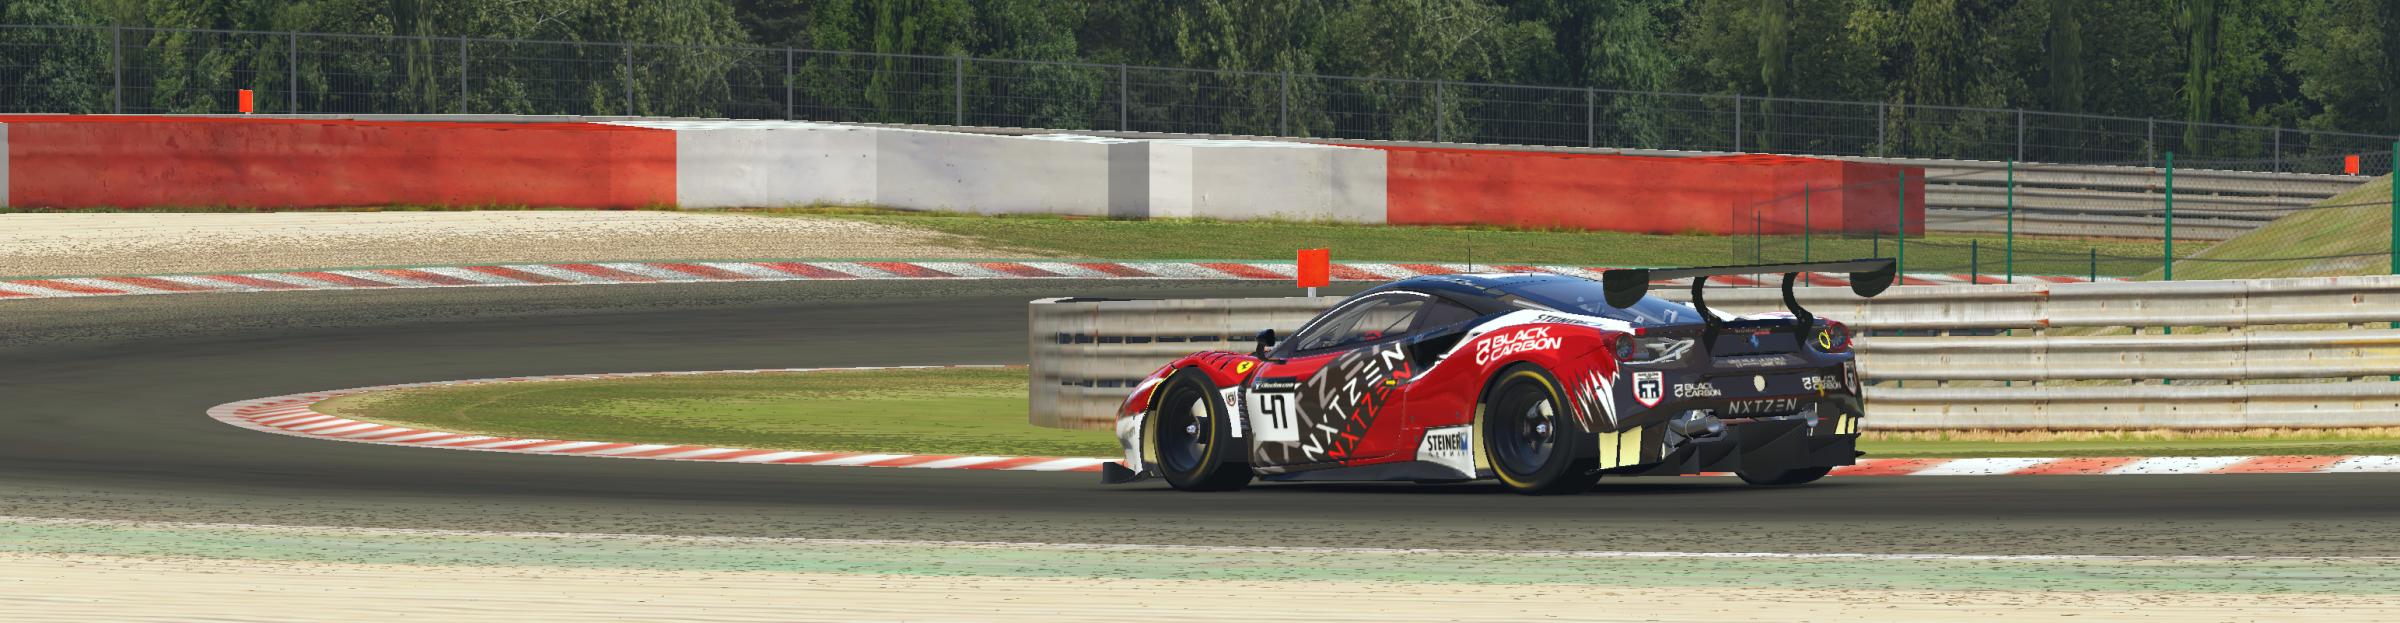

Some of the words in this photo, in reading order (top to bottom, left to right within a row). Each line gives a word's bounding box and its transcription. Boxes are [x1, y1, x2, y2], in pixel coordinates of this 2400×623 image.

[1492, 326, 1551, 349] BLACK
[1490, 337, 1562, 361] CARBON
[1684, 382, 1713, 390] BLACK
[1684, 389, 1722, 397] CARBON
[1302, 343, 1405, 461] NXTZEN
[1728, 398, 1797, 415] NXTZEN
[1427, 432, 1461, 451] STEINER
